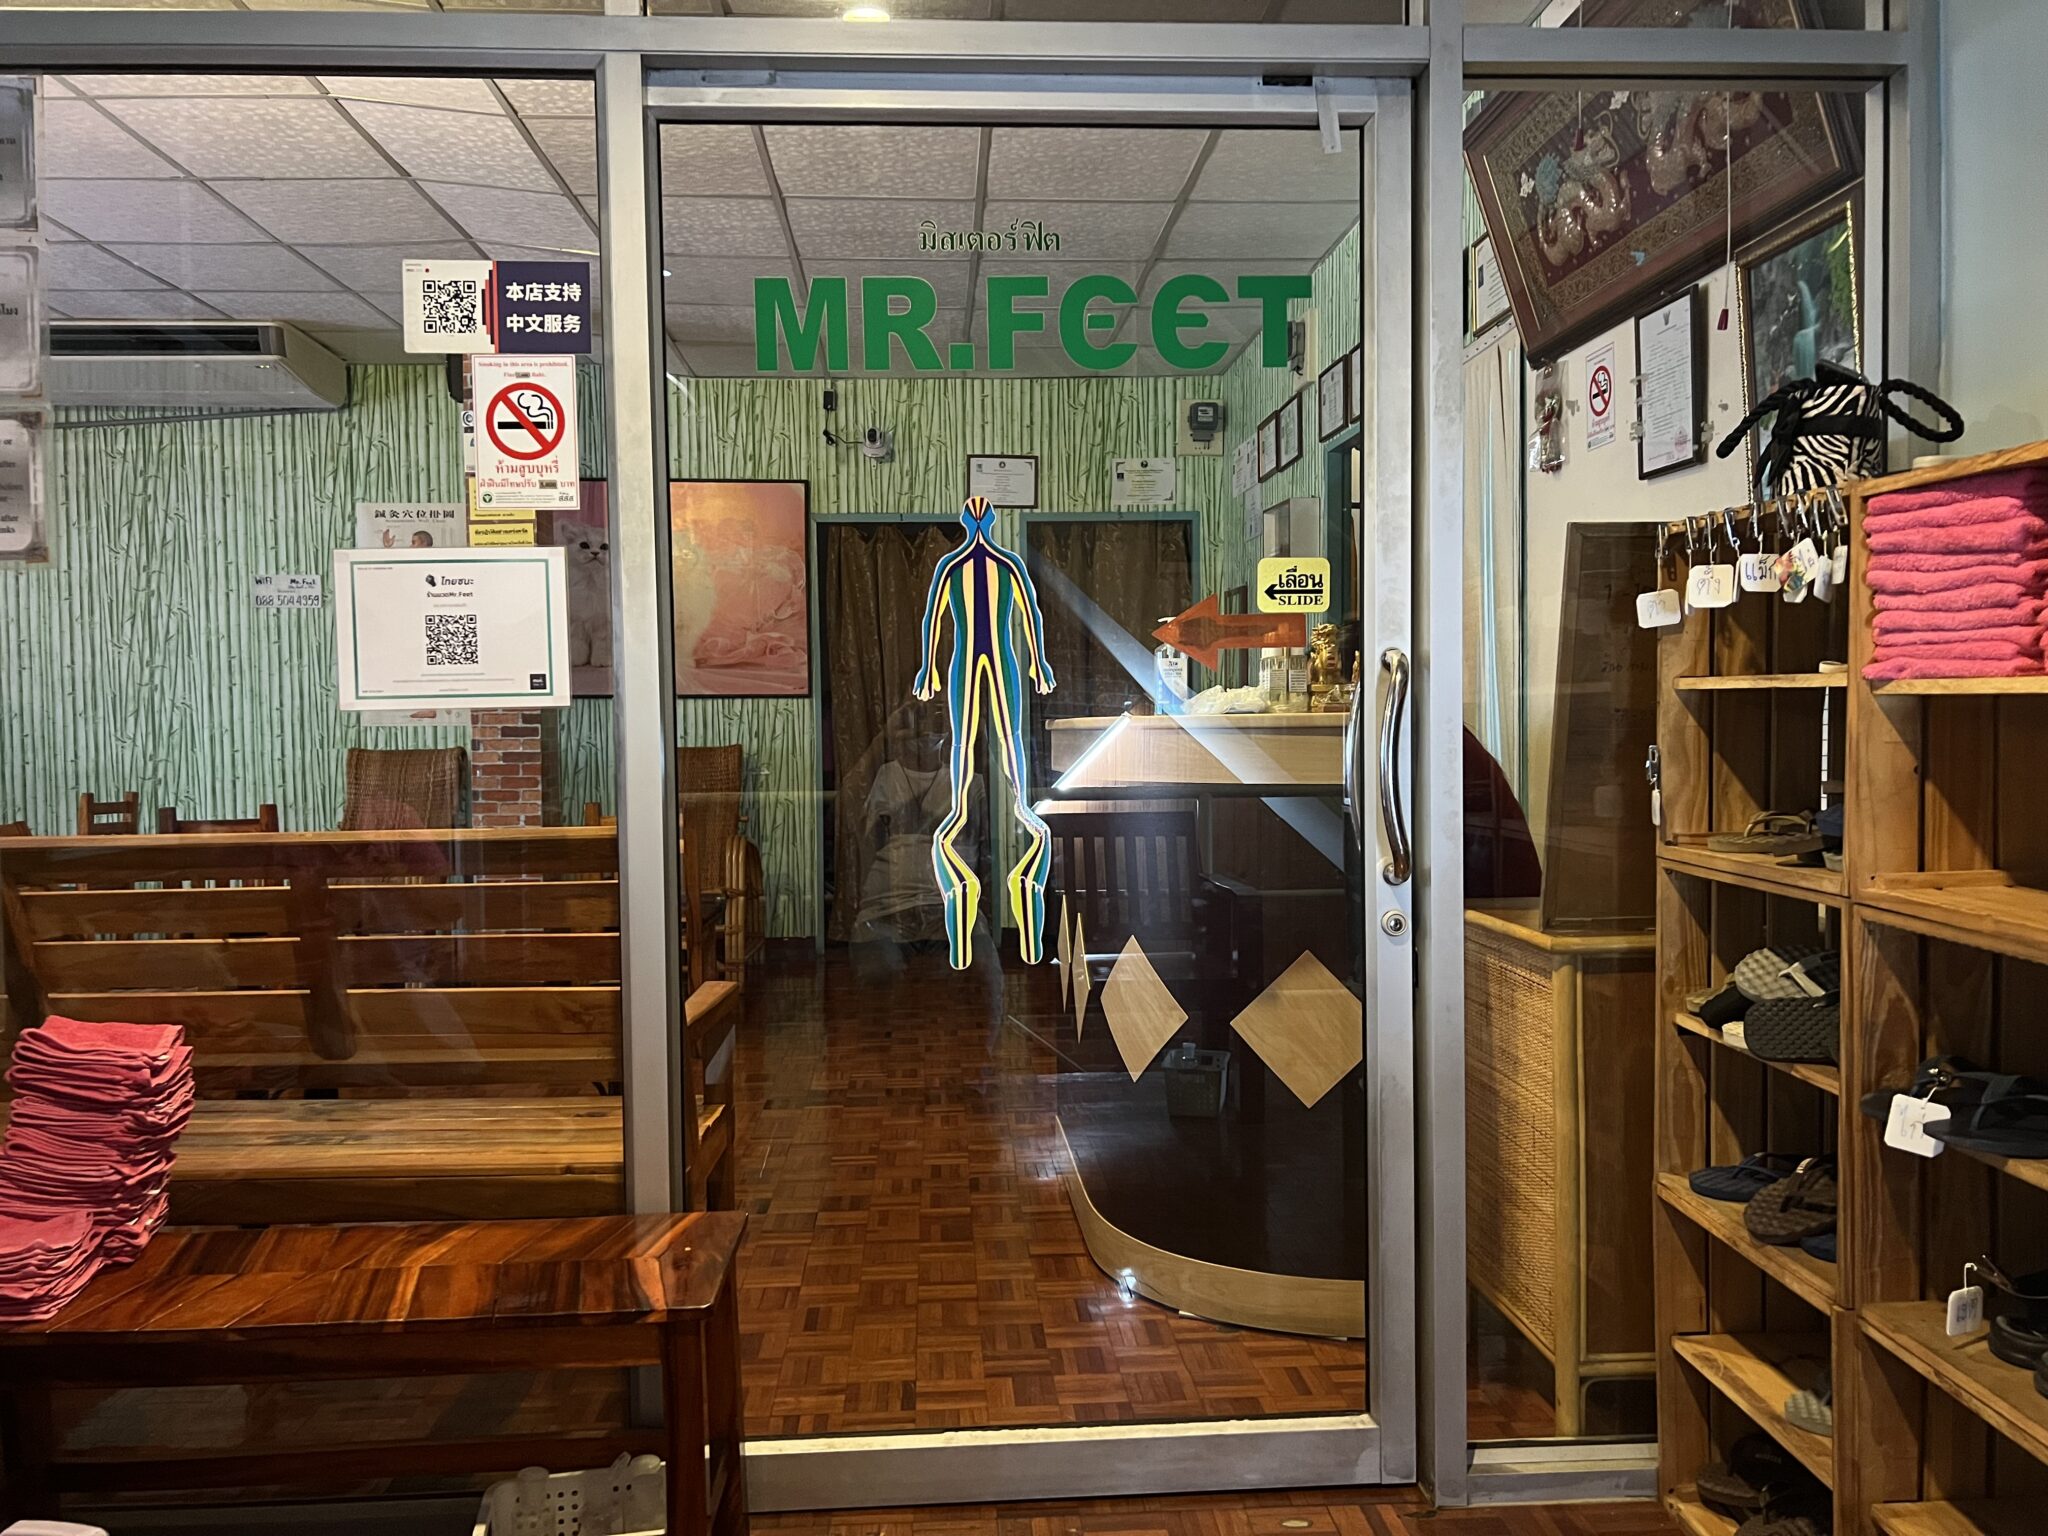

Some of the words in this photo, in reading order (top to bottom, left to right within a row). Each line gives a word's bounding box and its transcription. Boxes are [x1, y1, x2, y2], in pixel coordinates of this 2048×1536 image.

[918, 218, 1062, 253] มิสเตอร์ฟิต
[505, 282, 582, 303] 本店支持
[505, 313, 582, 334] 中文服务
[494, 456, 560, 478] ห้ามสูบบุหรี่
[560, 480, 576, 488] บาท
[441, 575, 475, 586] ไทยชนะ
[1278, 565, 1324, 589] เลื่อน
[1278, 595, 1324, 606] SLIDE
